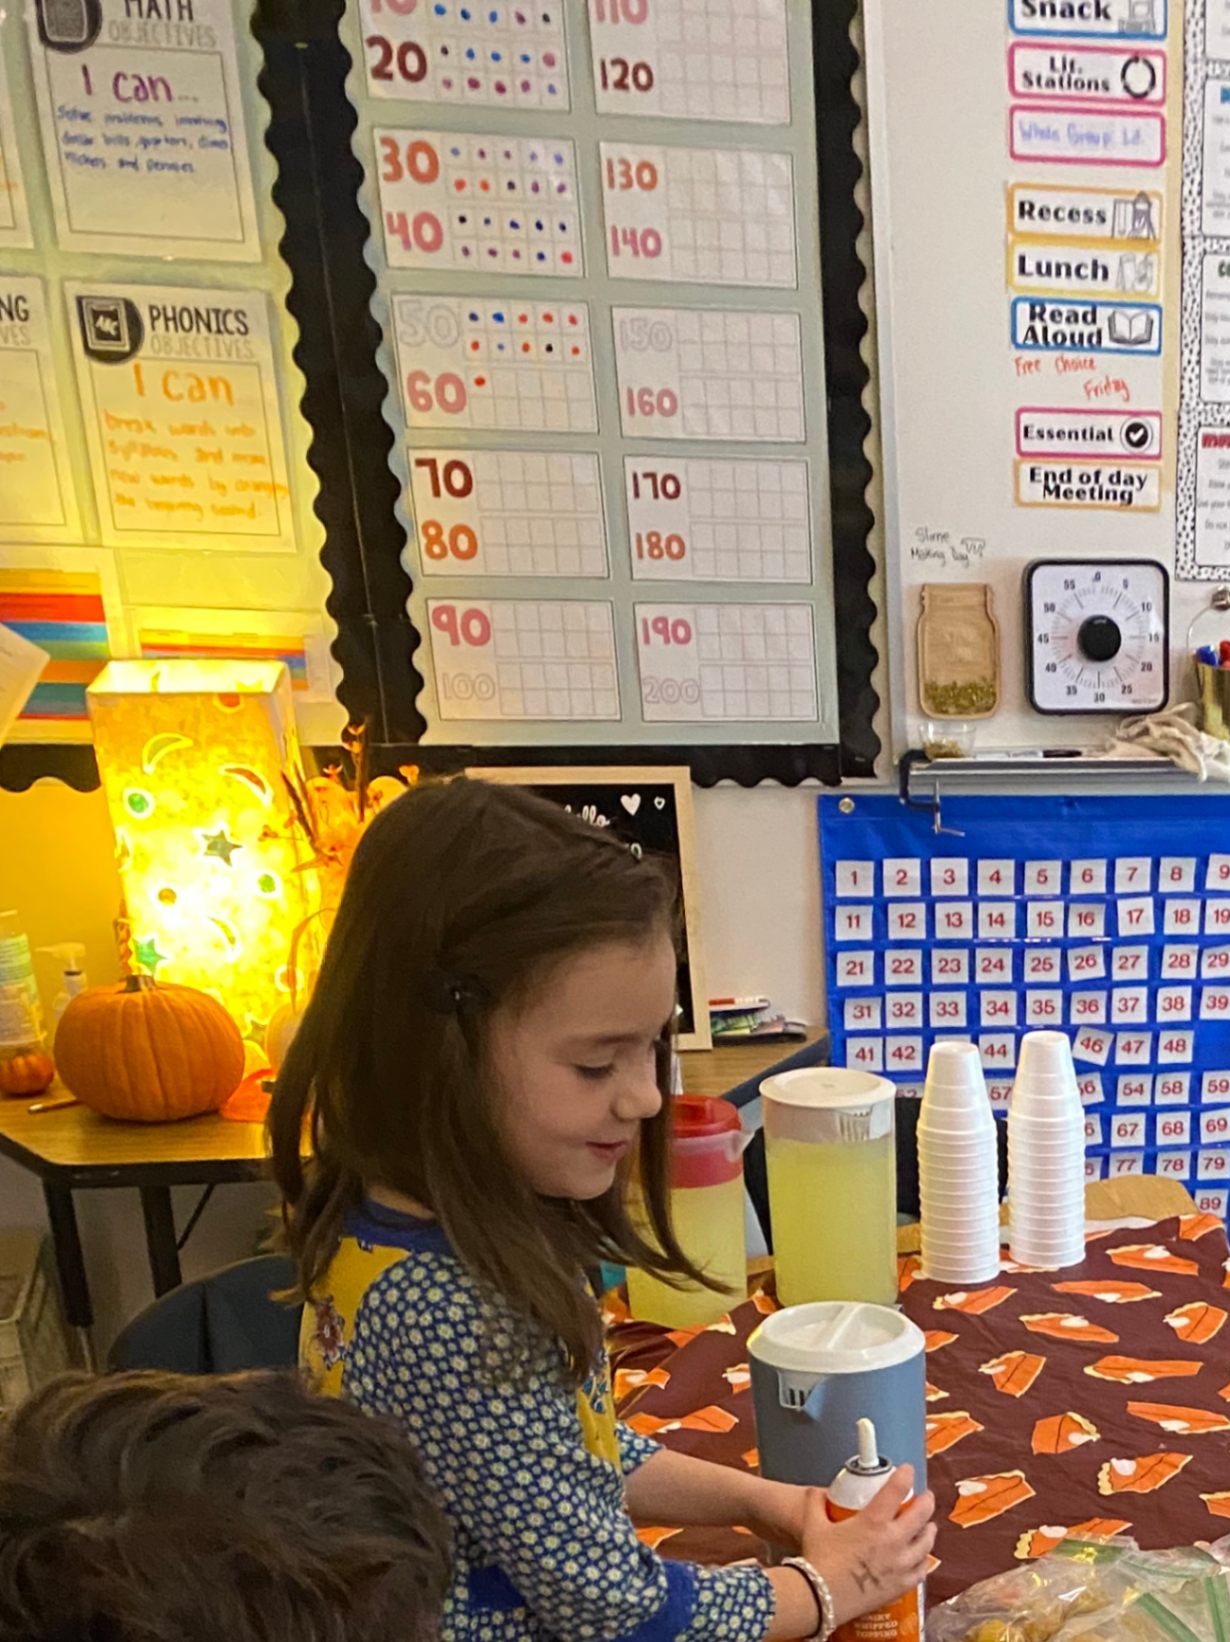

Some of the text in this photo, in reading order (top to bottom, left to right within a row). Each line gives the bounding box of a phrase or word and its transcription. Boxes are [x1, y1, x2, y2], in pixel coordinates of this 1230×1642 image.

[1021, 0, 1112, 20] Snack
[108, 19, 217, 48] OBJECTIVES
[365, 36, 427, 83] 20
[1050, 54, 1083, 74] Lit.
[601, 58, 654, 92] 120
[1022, 71, 1110, 92] Stations
[380, 137, 440, 184] 30
[607, 158, 657, 191] 130
[1018, 200, 1107, 224] Recess
[386, 211, 443, 253] 40
[611, 226, 661, 259] 140
[1018, 254, 1110, 281] Lunch
[149, 304, 249, 336] PHONICS
[1029, 303, 1097, 325] Read
[1022, 325, 1102, 347] Aloud
[150, 335, 255, 359] OBJECTIVES
[162, 369, 234, 407] can
[407, 371, 466, 414] 60
[627, 387, 677, 417] 160
[1023, 424, 1114, 442] Essential
[415, 458, 473, 498] 70
[633, 472, 681, 501] 170
[1029, 467, 1147, 491] End of day
[1043, 484, 1134, 505] Meeting
[422, 520, 478, 561] 80
[635, 531, 686, 560] 180
[1064, 579, 1075, 590] 55
[1123, 579, 1128, 589] 5
[1044, 603, 1056, 613] 50
[1142, 602, 1152, 612] 10
[431, 605, 491, 647] 90
[641, 617, 691, 645] 190
[1038, 633, 1049, 644] 45
[1149, 632, 1160, 643] 15
[1045, 663, 1057, 673] 40
[1141, 662, 1152, 672] 20
[1066, 686, 1077, 696] 35
[1094, 692, 1105, 703] 30
[1121, 685, 1132, 695] 25
[849, 870, 859, 884] 1
[895, 868, 908, 887] 2
[942, 868, 956, 886] 3
[986, 869, 1002, 885] 4
[1035, 869, 1048, 886] 5
[1080, 868, 1093, 884] 6
[1126, 866, 1138, 882] 7
[1169, 866, 1182, 881] 8
[847, 914, 861, 928] 11
[895, 912, 916, 929] 12
[943, 912, 964, 929] 13
[986, 912, 1007, 927] 14
[1035, 911, 1055, 928] 15
[1076, 912, 1096, 927] 16
[1126, 907, 1145, 924] 17
[1173, 908, 1191, 924] 18
[846, 960, 864, 976] 21
[891, 958, 915, 975] 22
[936, 957, 961, 974] 23
[980, 957, 1006, 974] 24
[1029, 957, 1053, 973] 25
[1074, 953, 1098, 971] 26
[1118, 954, 1140, 971] 27
[1167, 952, 1192, 970] 28
[1207, 953, 1230, 969] 29
[893, 1002, 916, 1018] 32
[937, 1001, 960, 1018] 33
[986, 999, 1011, 1017] 34
[1032, 998, 1056, 1016] 35
[1076, 999, 1100, 1014] 36
[1119, 997, 1139, 1013] 37
[1163, 996, 1185, 1012] 38
[1206, 995, 1229, 1010] 39
[853, 1005, 872, 1020] 31
[890, 1045, 916, 1062] 42
[984, 1043, 1008, 1058] 44
[1079, 1036, 1104, 1054] 46
[1120, 1039, 1143, 1054] 47
[1162, 1038, 1187, 1054] 48
[855, 1047, 873, 1062] 41
[989, 1086, 1012, 1099] 57
[1121, 1083, 1145, 1097] 54
[1161, 1080, 1184, 1096] 58
[1207, 1079, 1230, 1094] 59
[1115, 1122, 1137, 1137] 67
[1160, 1120, 1184, 1137] 68
[1204, 1118, 1227, 1133] 69
[1115, 1158, 1136, 1172] 77
[1162, 1158, 1184, 1171] 78
[1203, 1157, 1225, 1170] 79
[1200, 1197, 1221, 1210] 89
